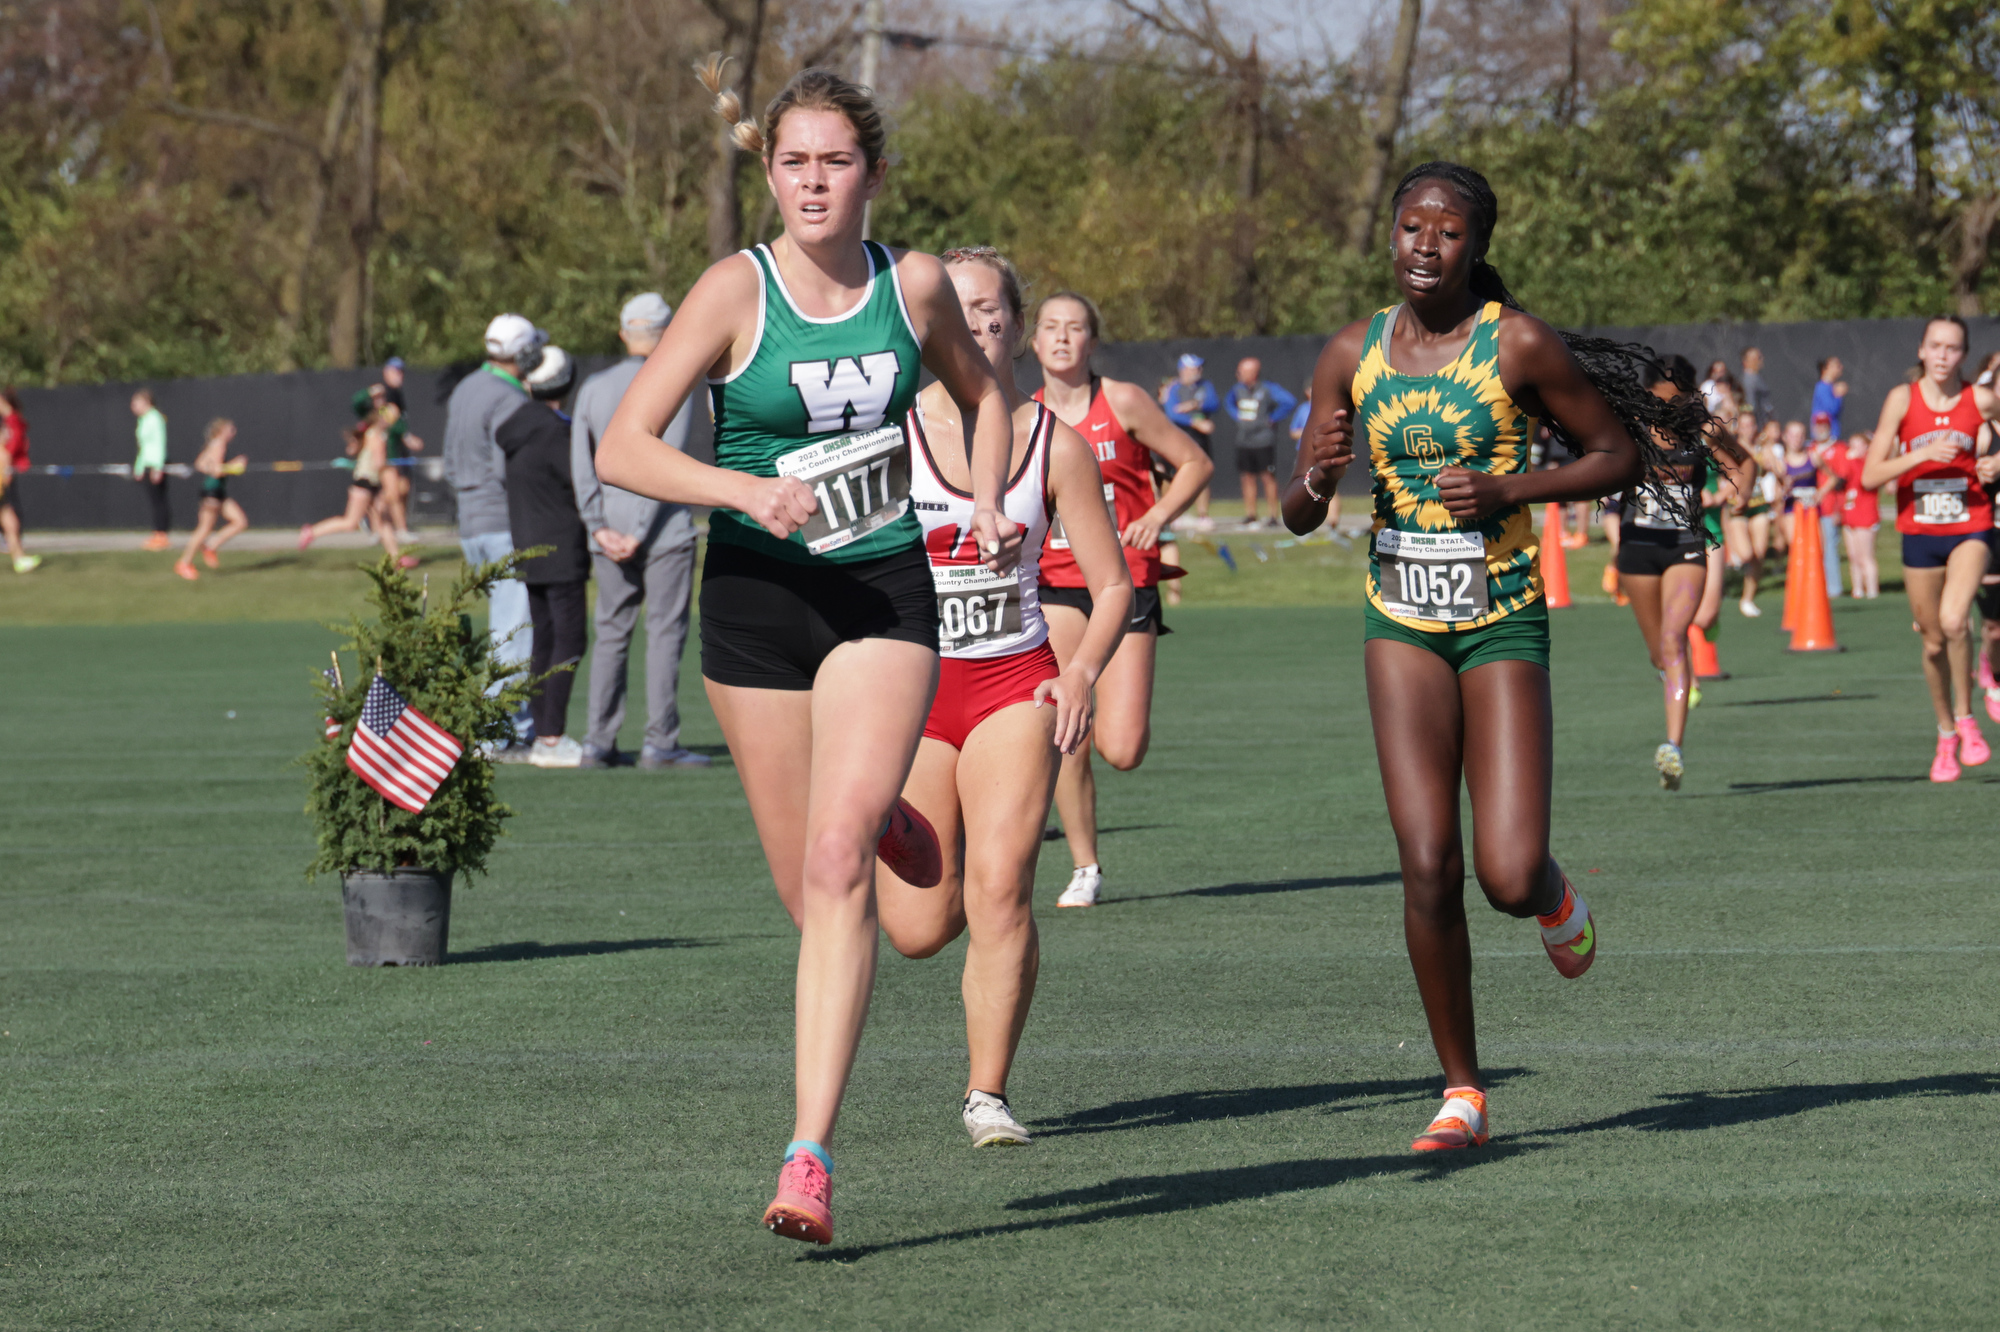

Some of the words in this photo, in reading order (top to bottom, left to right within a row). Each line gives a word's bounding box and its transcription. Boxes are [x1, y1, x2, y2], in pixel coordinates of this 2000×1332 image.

[789, 349, 902, 434] W
[783, 465, 807, 478] Cross
[808, 453, 840, 469] Country
[842, 431, 901, 457] Championships
[797, 450, 819, 463] 2023
[822, 436, 852, 454] OHSAA
[855, 428, 881, 442] STATE
[1094, 440, 1117, 462] IN
[813, 456, 891, 529] 1177
[1377, 540, 1395, 549] Cross
[1396, 544, 1423, 553] Country
[1391, 534, 1407, 542] 2023
[1410, 536, 1437, 545] OHSAA
[949, 568, 976, 578] OHSAA
[1394, 561, 1474, 606] 1052
